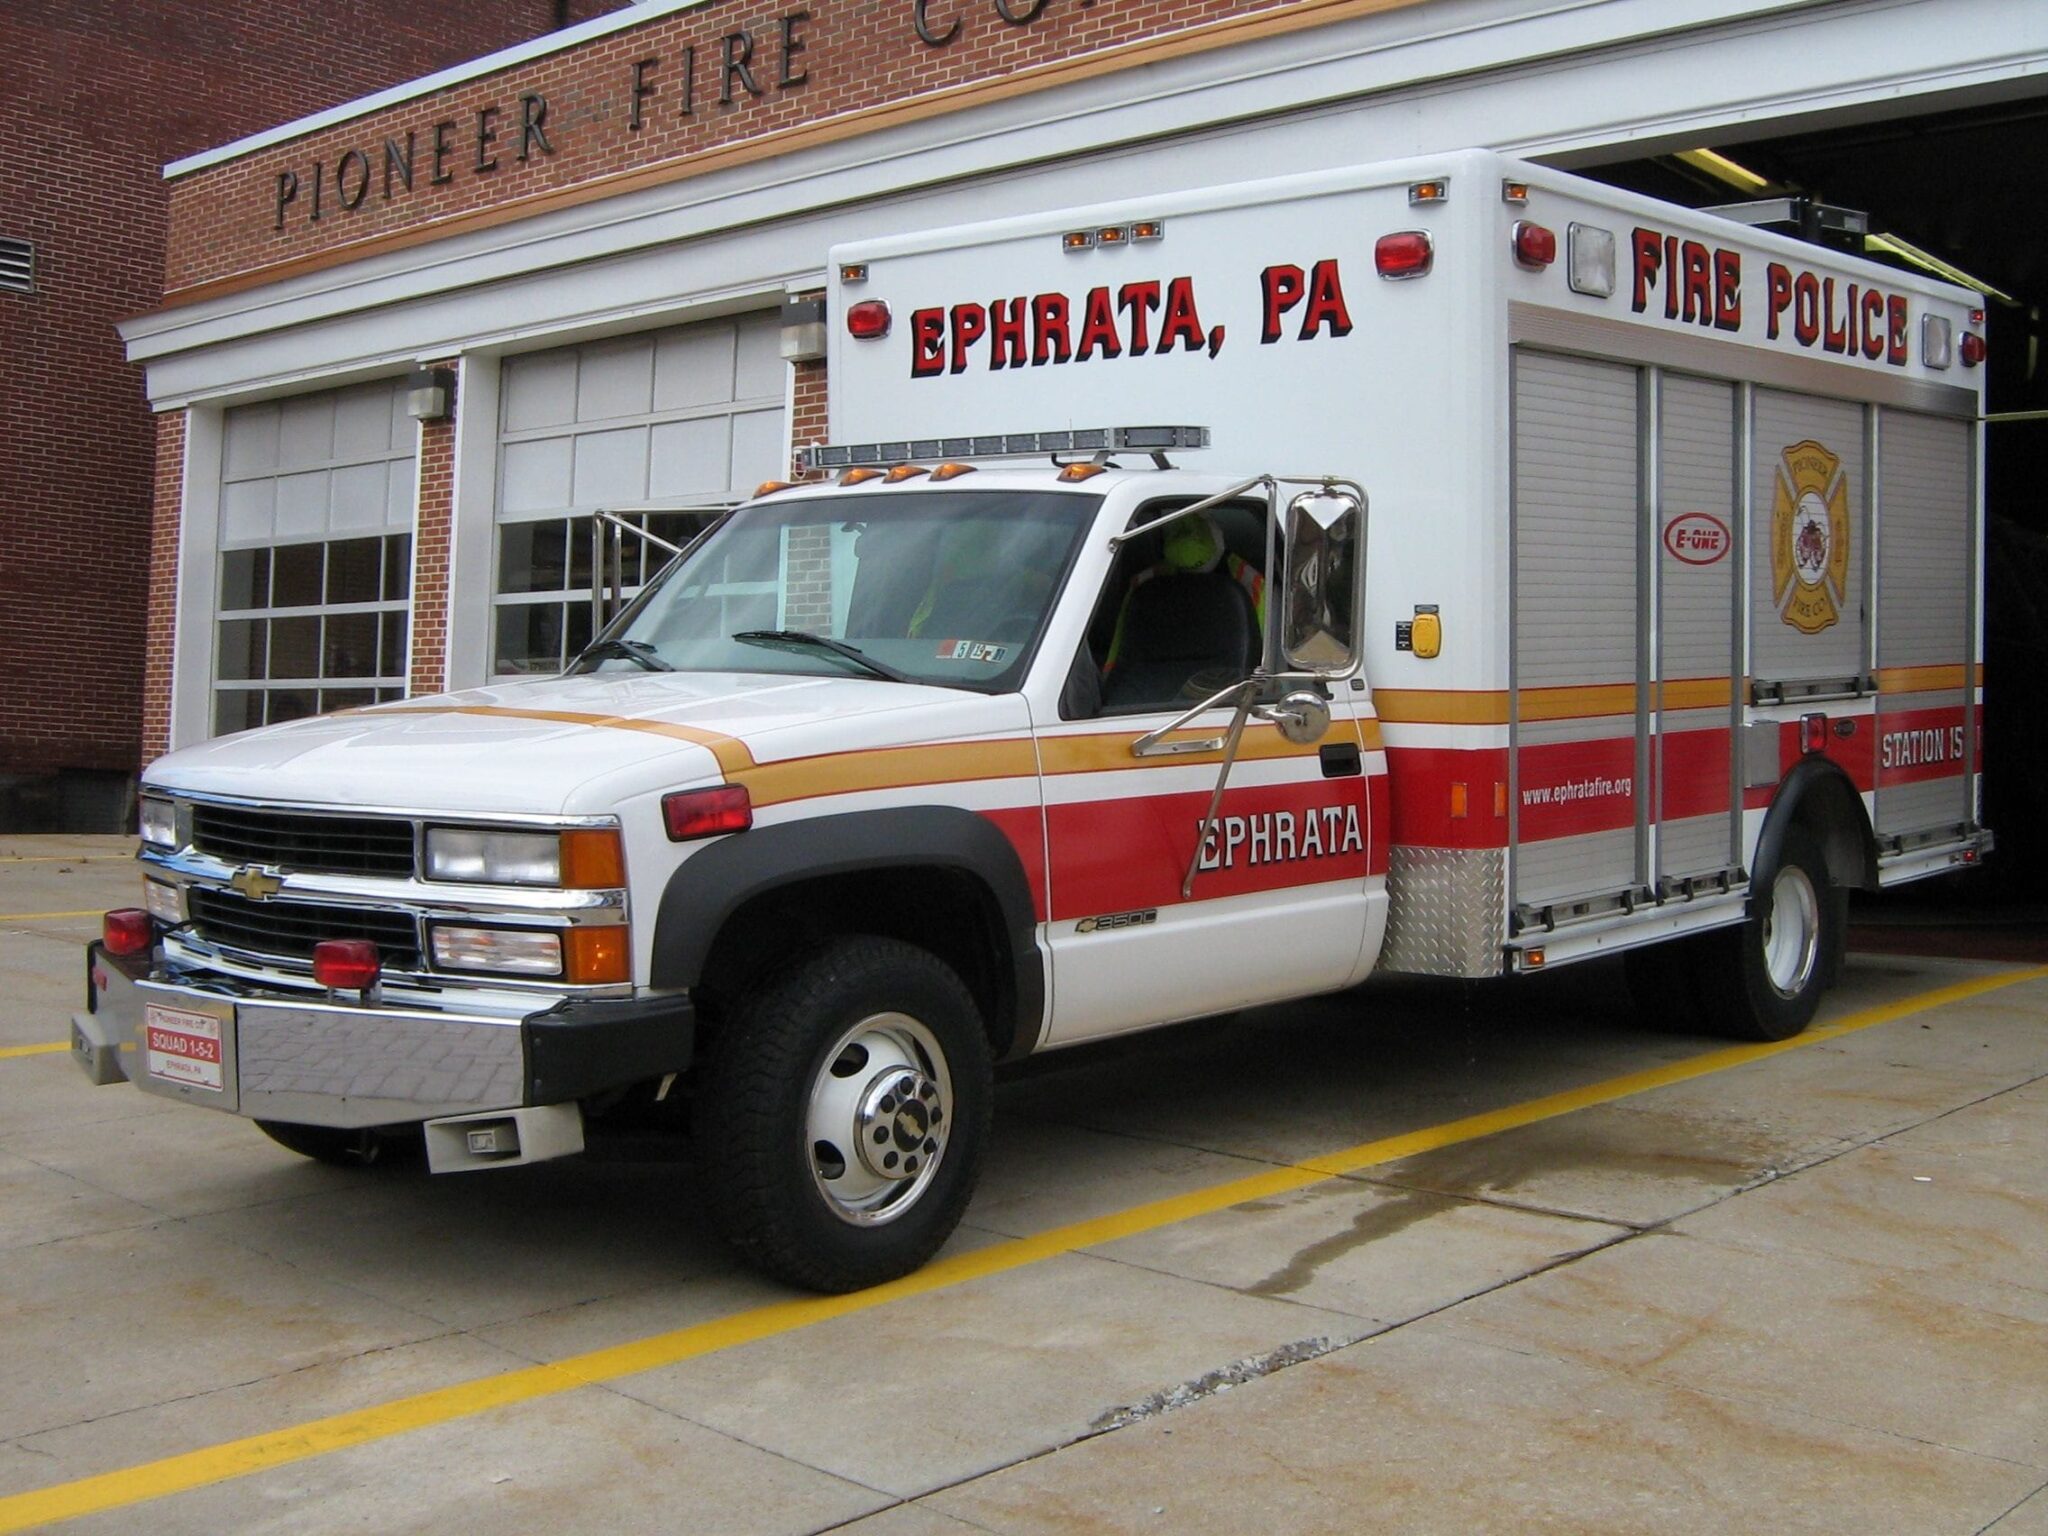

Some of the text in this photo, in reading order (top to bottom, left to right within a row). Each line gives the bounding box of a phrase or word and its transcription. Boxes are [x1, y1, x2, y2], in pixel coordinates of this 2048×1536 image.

[275, 12, 810, 230] PIONEER FIRE
[910, 259, 1353, 378] EPHRATA, PA
[1631, 226, 1908, 366] FIRE POLICE
[1882, 728, 1944, 768] STATION
[1522, 777, 1632, 806] www.ephratafire.org
[1198, 805, 1363, 870] EPHRATA
[1097, 909, 1158, 931] 3500
[152, 1032, 214, 1059] SQUAD 1-5-2
